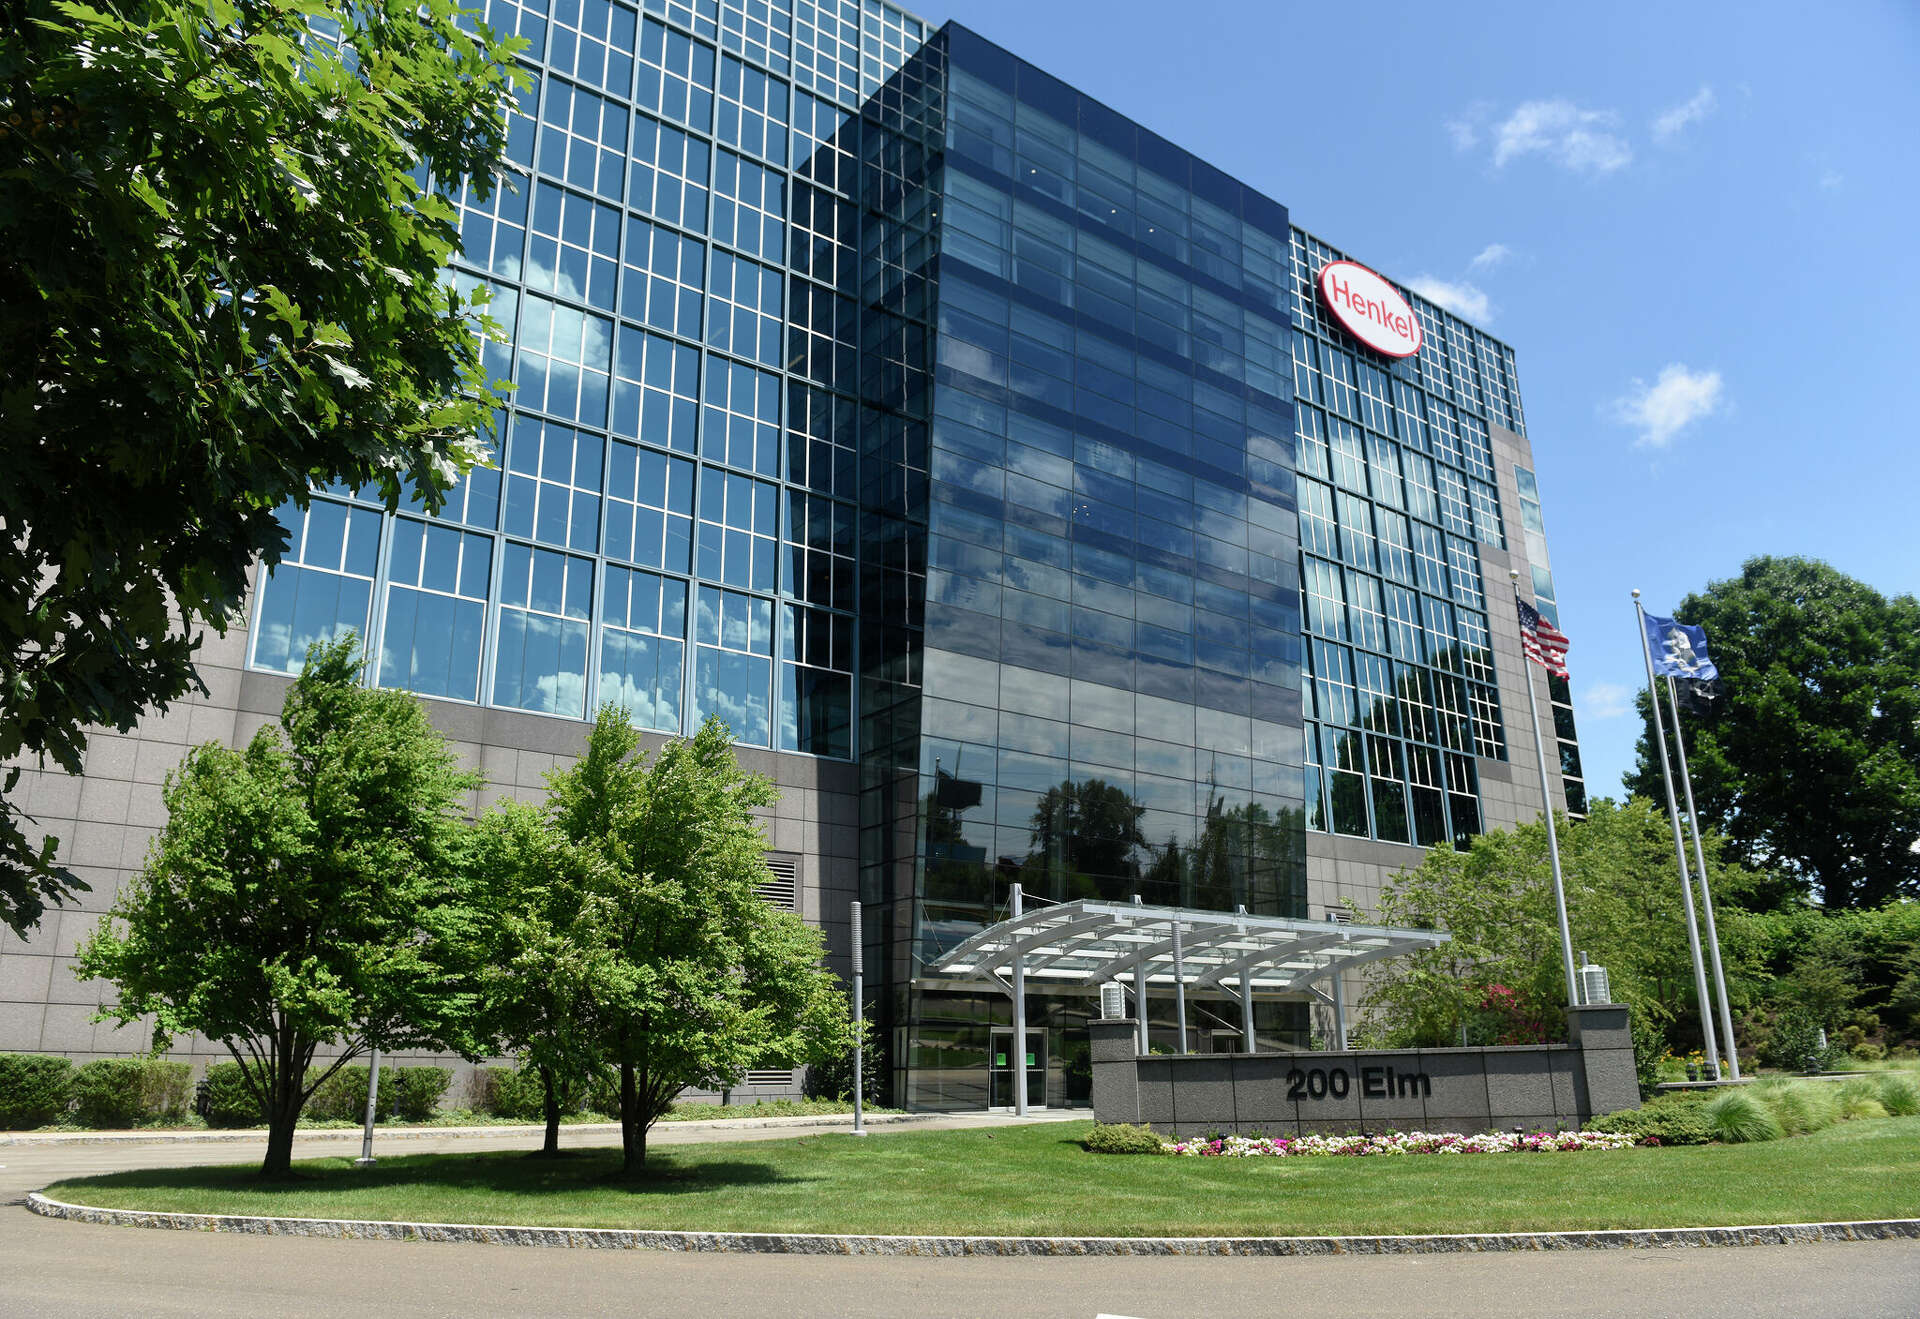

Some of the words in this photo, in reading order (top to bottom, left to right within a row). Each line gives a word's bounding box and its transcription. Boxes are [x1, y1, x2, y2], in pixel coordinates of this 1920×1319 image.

[1331, 273, 1415, 342] Henkel
[1286, 1067, 1350, 1101] 200
[1361, 1066, 1432, 1099] Elm
